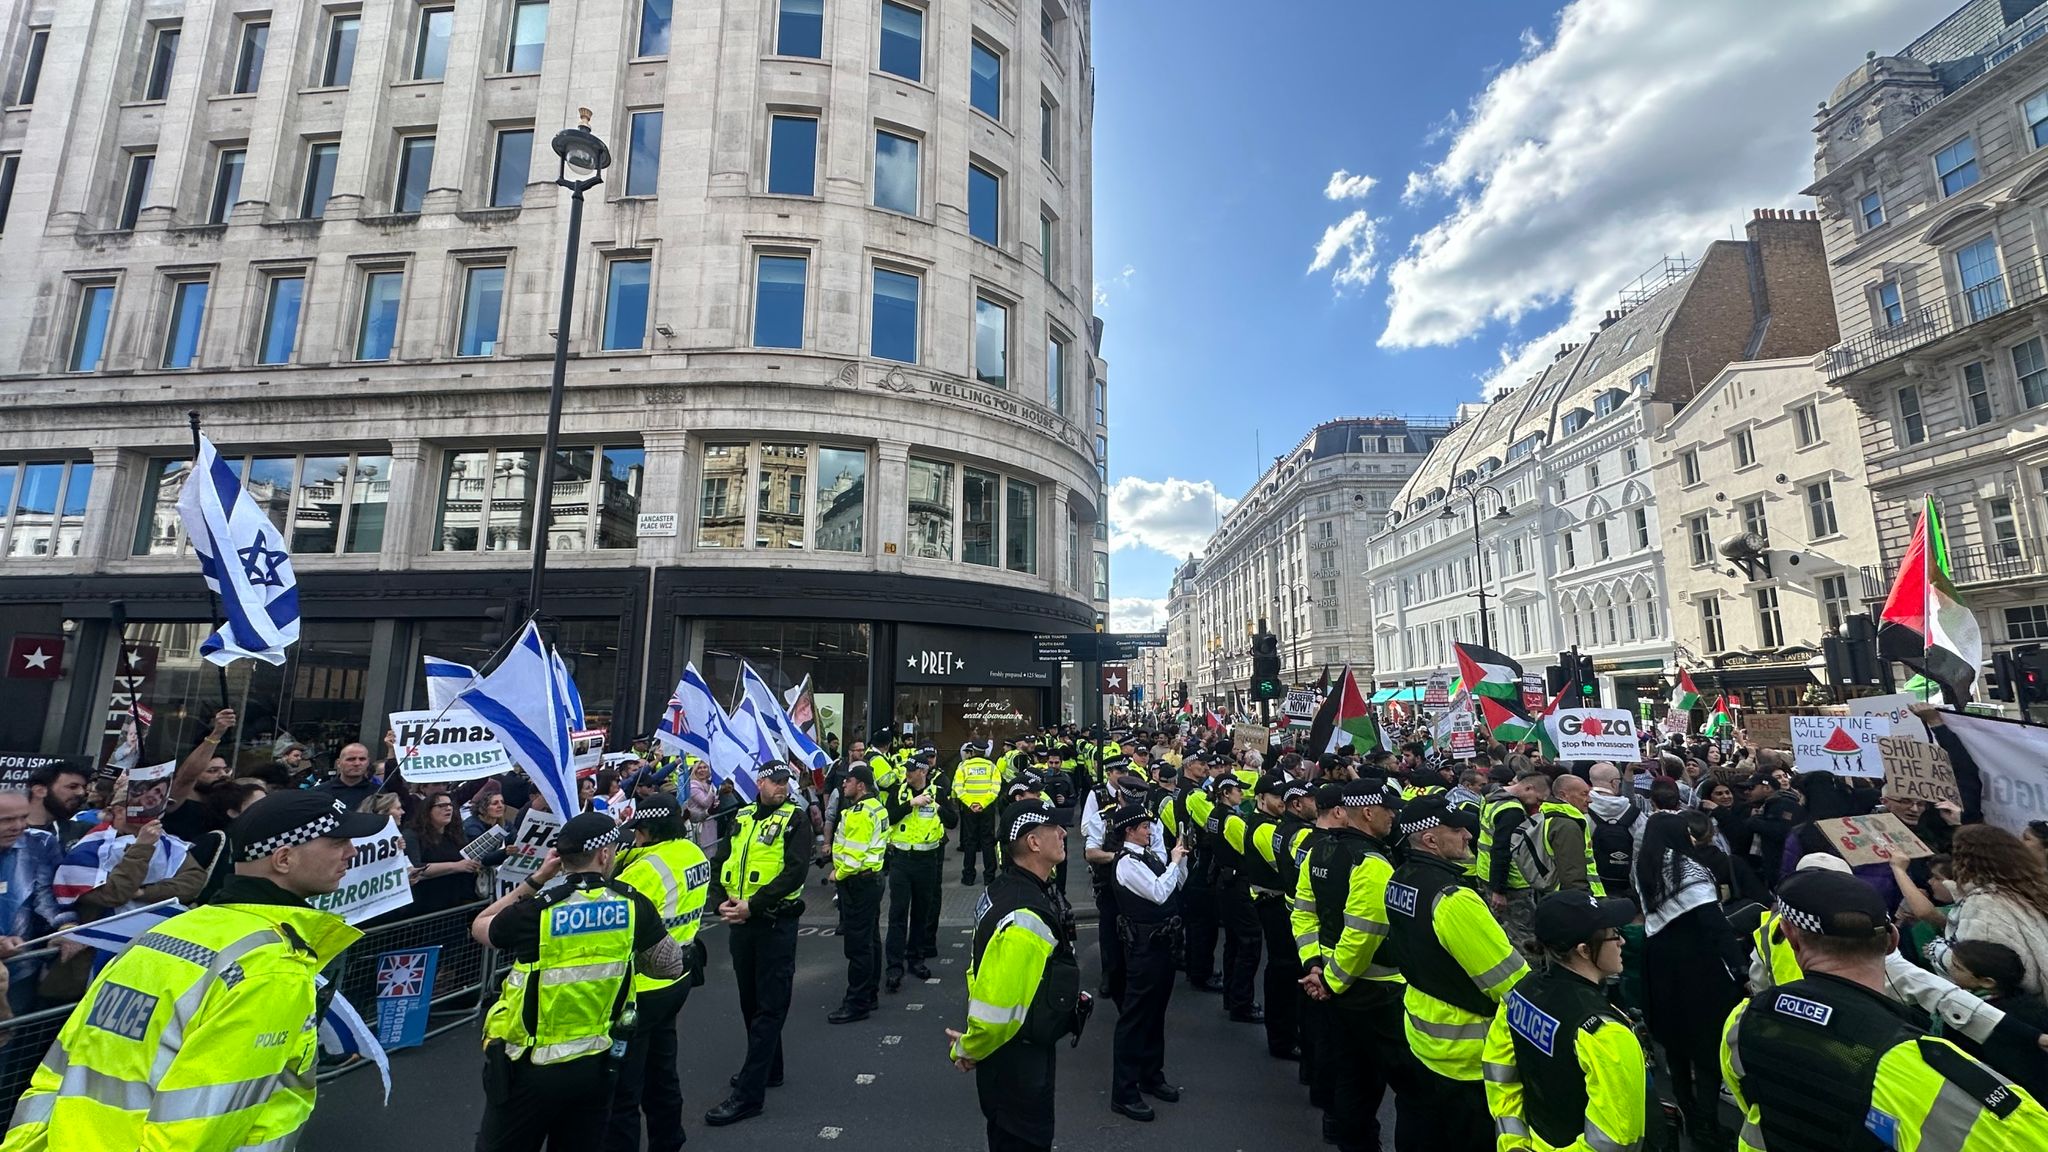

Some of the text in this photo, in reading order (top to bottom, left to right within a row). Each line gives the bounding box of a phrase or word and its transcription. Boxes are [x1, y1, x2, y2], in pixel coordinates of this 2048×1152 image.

[930, 380, 1054, 429] WELLINGTON HOUSE
[1311, 539, 1338, 550] Strand
[1312, 569, 1340, 580] Palace
[1317, 598, 1338, 608] Hotel
[921, 650, 953, 675] PRET
[1784, 652, 1812, 661] TAVERN
[1288, 692, 1314, 703] CEASEFIRE
[1290, 701, 1311, 712] NOW!
[1794, 717, 1873, 730] PALESTINE
[400, 724, 495, 747] Hamas
[1562, 740, 1580, 749] Stop
[1597, 741, 1635, 749] massacre
[1795, 730, 1826, 739] WILL
[1862, 732, 1878, 743] BE
[1797, 744, 1824, 757] FREE
[1879, 738, 1922, 759] SHUT
[0, 757, 25, 768] FOR
[400, 749, 502, 770] TERRORIST
[1884, 757, 1924, 778] THE
[687, 863, 709, 888] POLICE
[1312, 865, 1328, 879] POLICE
[308, 868, 404, 911] TERRORIST
[556, 905, 626, 931] POLICE
[1779, 998, 1825, 1020] POLICE
[380, 1000, 397, 1043] DECLARATION
[390, 999, 409, 1043] OCTOBER
[1510, 995, 1553, 1047] POLICE
[254, 1030, 289, 1049] POLICE
[1985, 1085, 2009, 1107] 5637
